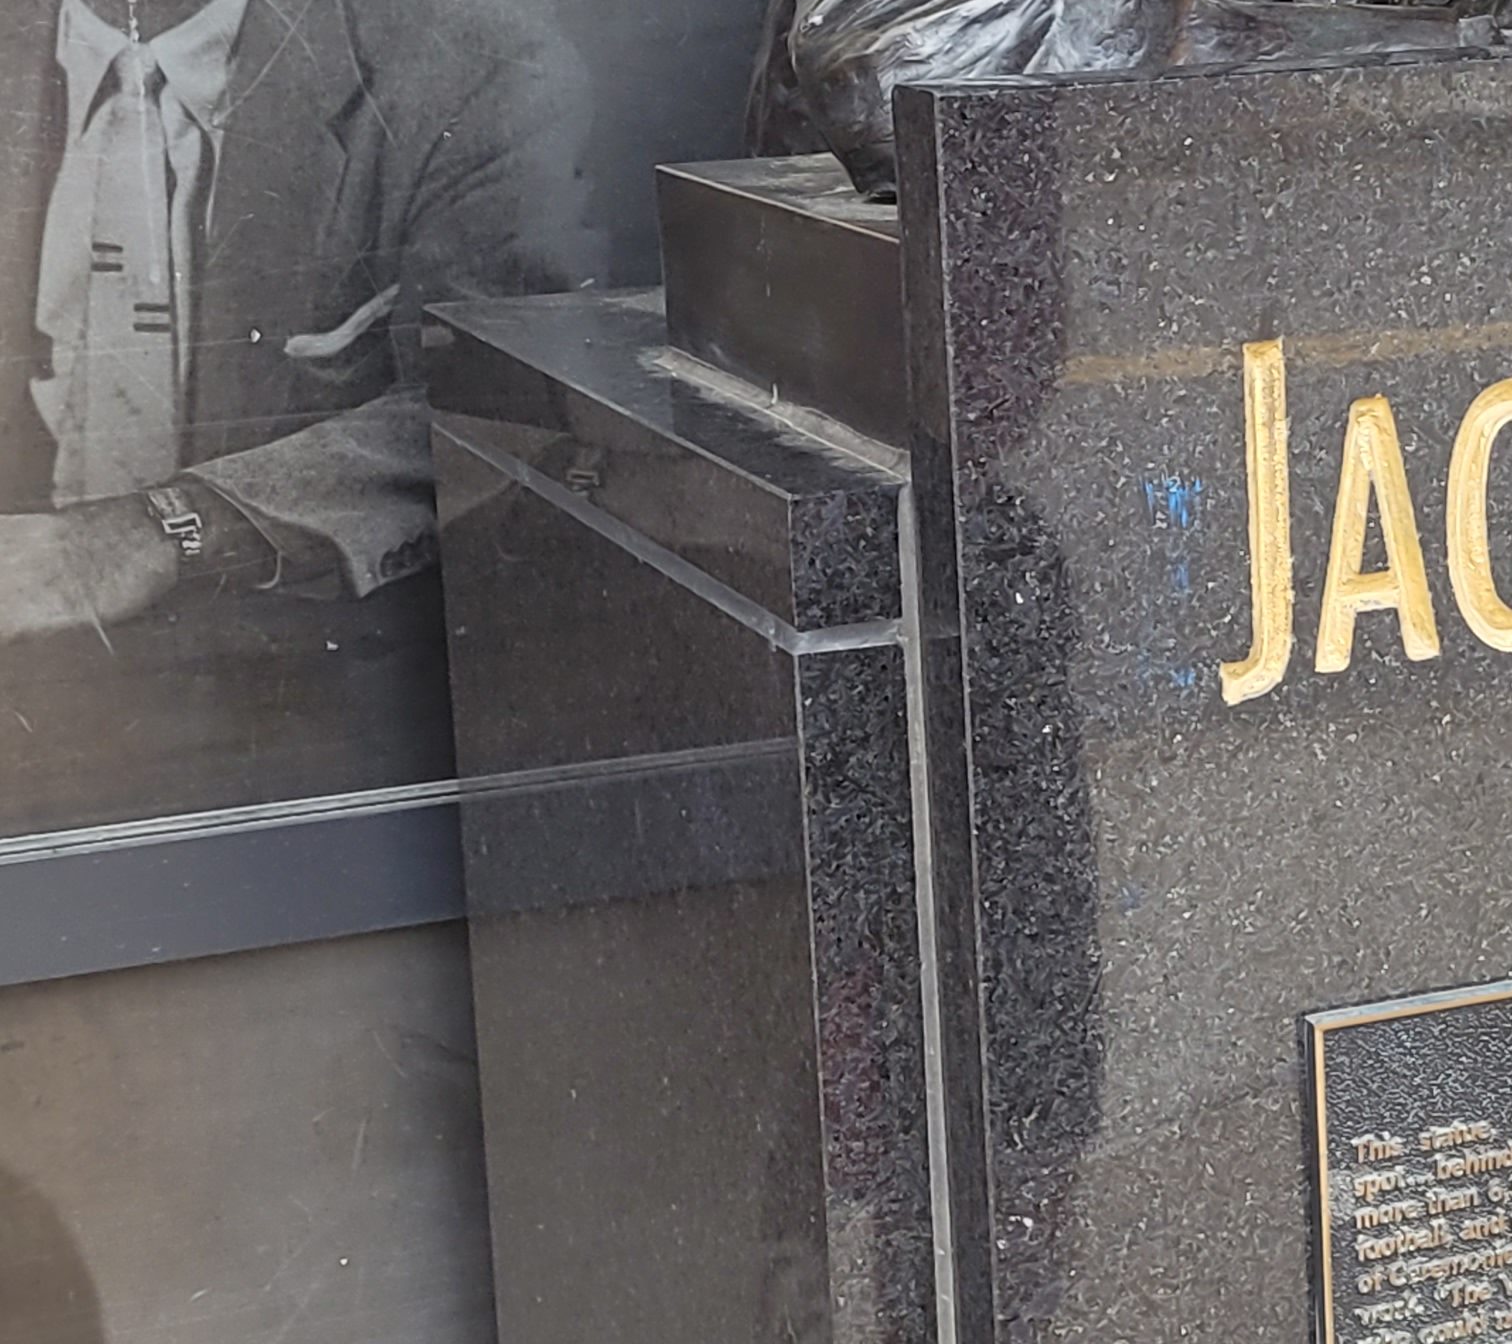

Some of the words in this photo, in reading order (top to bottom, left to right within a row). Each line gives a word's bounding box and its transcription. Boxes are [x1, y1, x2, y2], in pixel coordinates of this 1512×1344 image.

[1351, 1130, 1403, 1162] This
[1354, 1197, 1420, 1228] more
[1425, 1182, 1478, 1214] than
[1457, 1210, 1507, 1241] and
[1356, 1266, 1382, 1296] of
